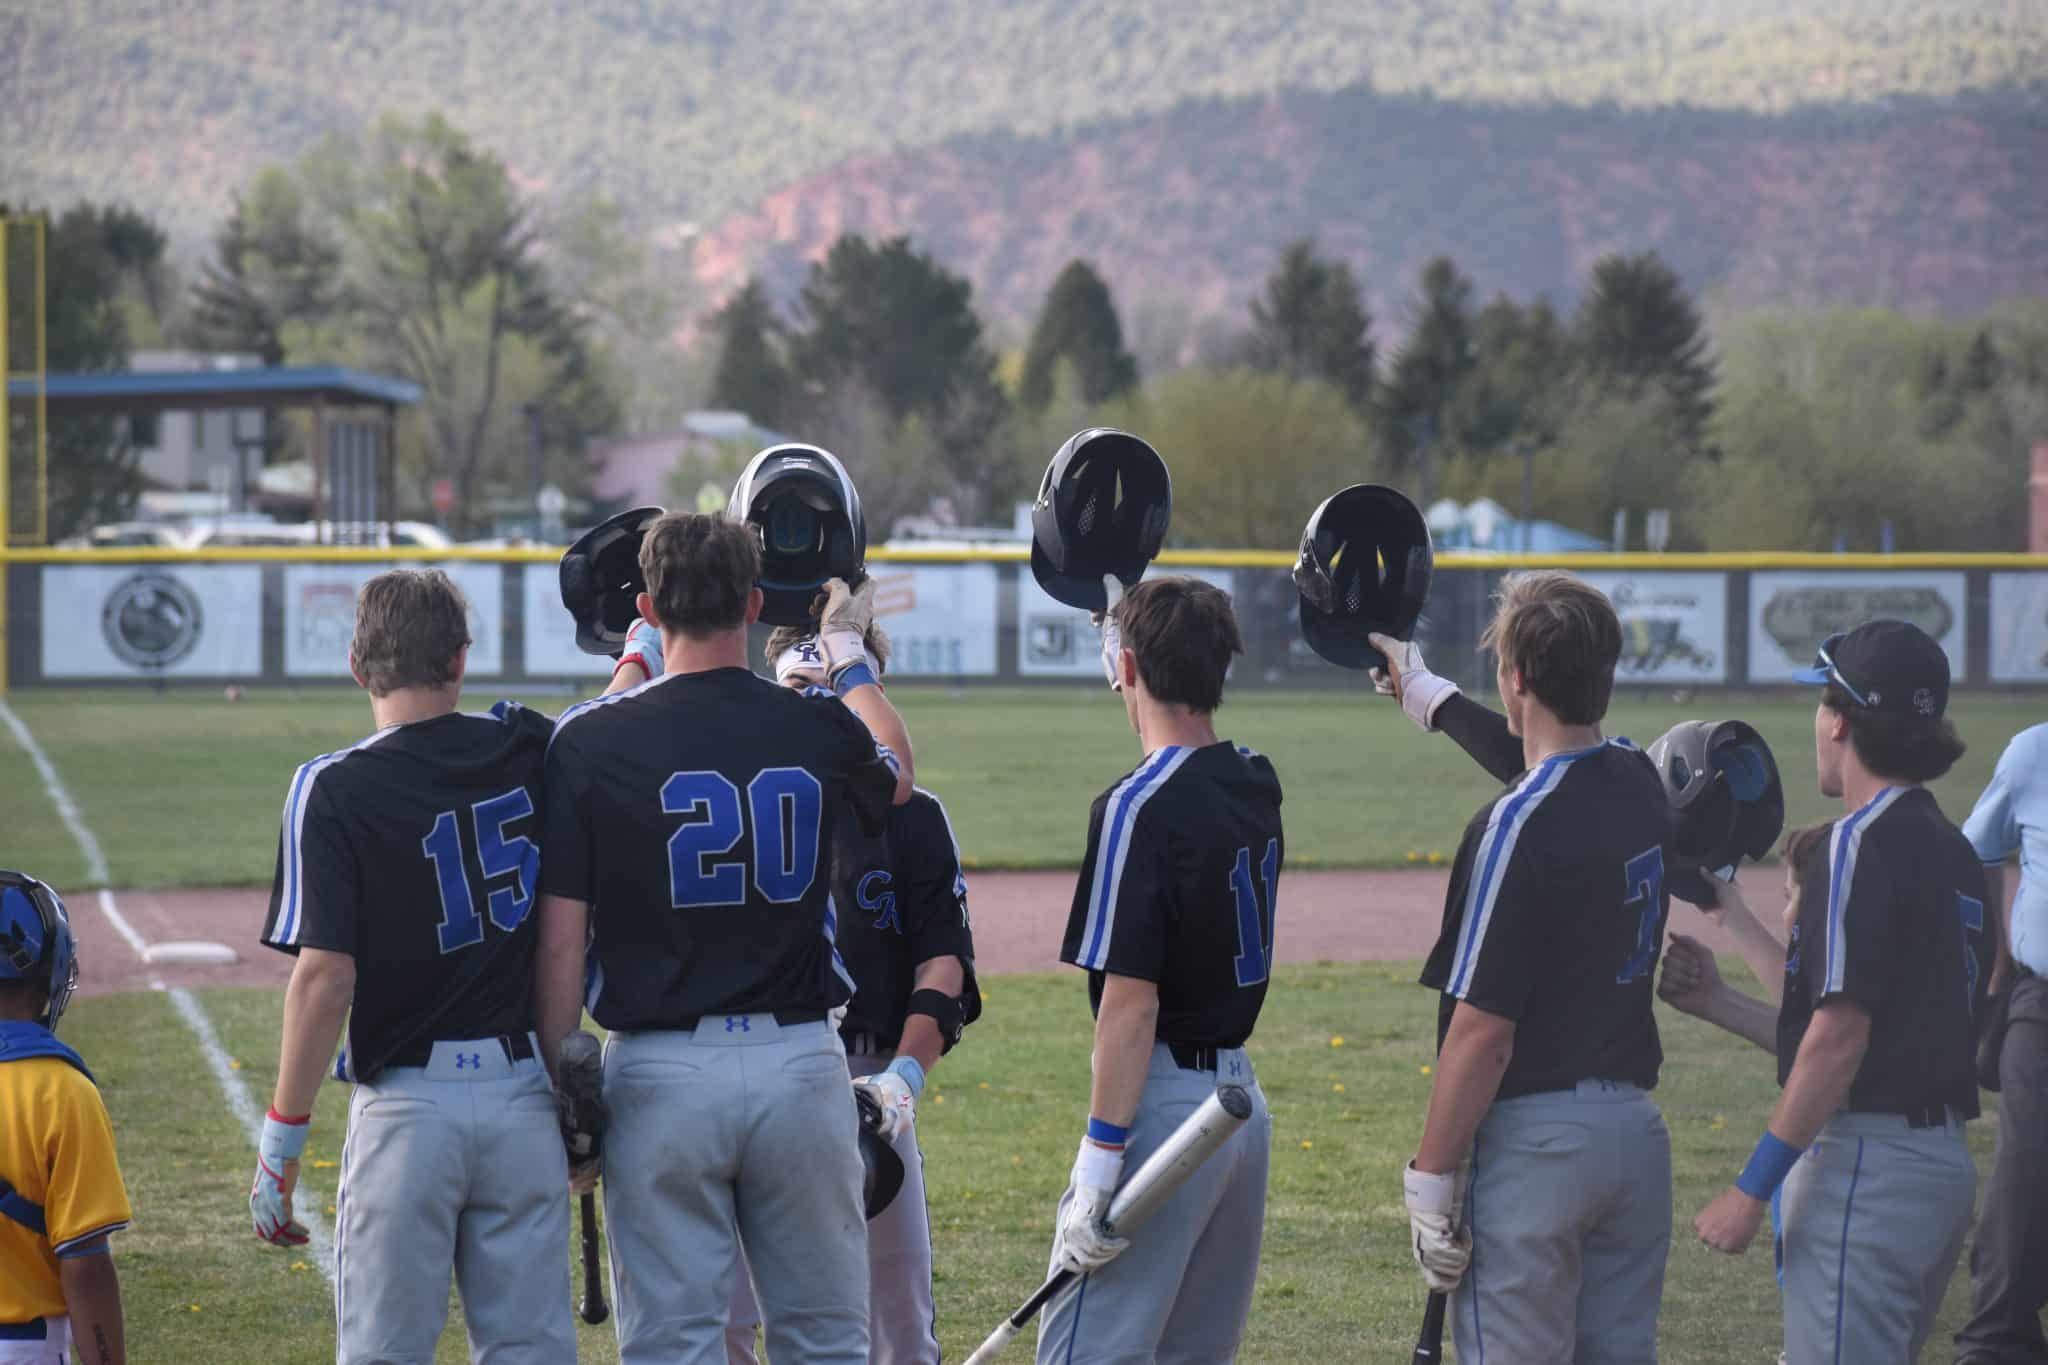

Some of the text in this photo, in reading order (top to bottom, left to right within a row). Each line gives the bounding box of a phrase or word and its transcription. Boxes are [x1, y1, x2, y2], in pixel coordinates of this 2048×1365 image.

[421, 786, 540, 954] 15
[660, 767, 823, 908] 20
[1229, 838, 1279, 988] 11
[1616, 844, 1665, 985] 7
